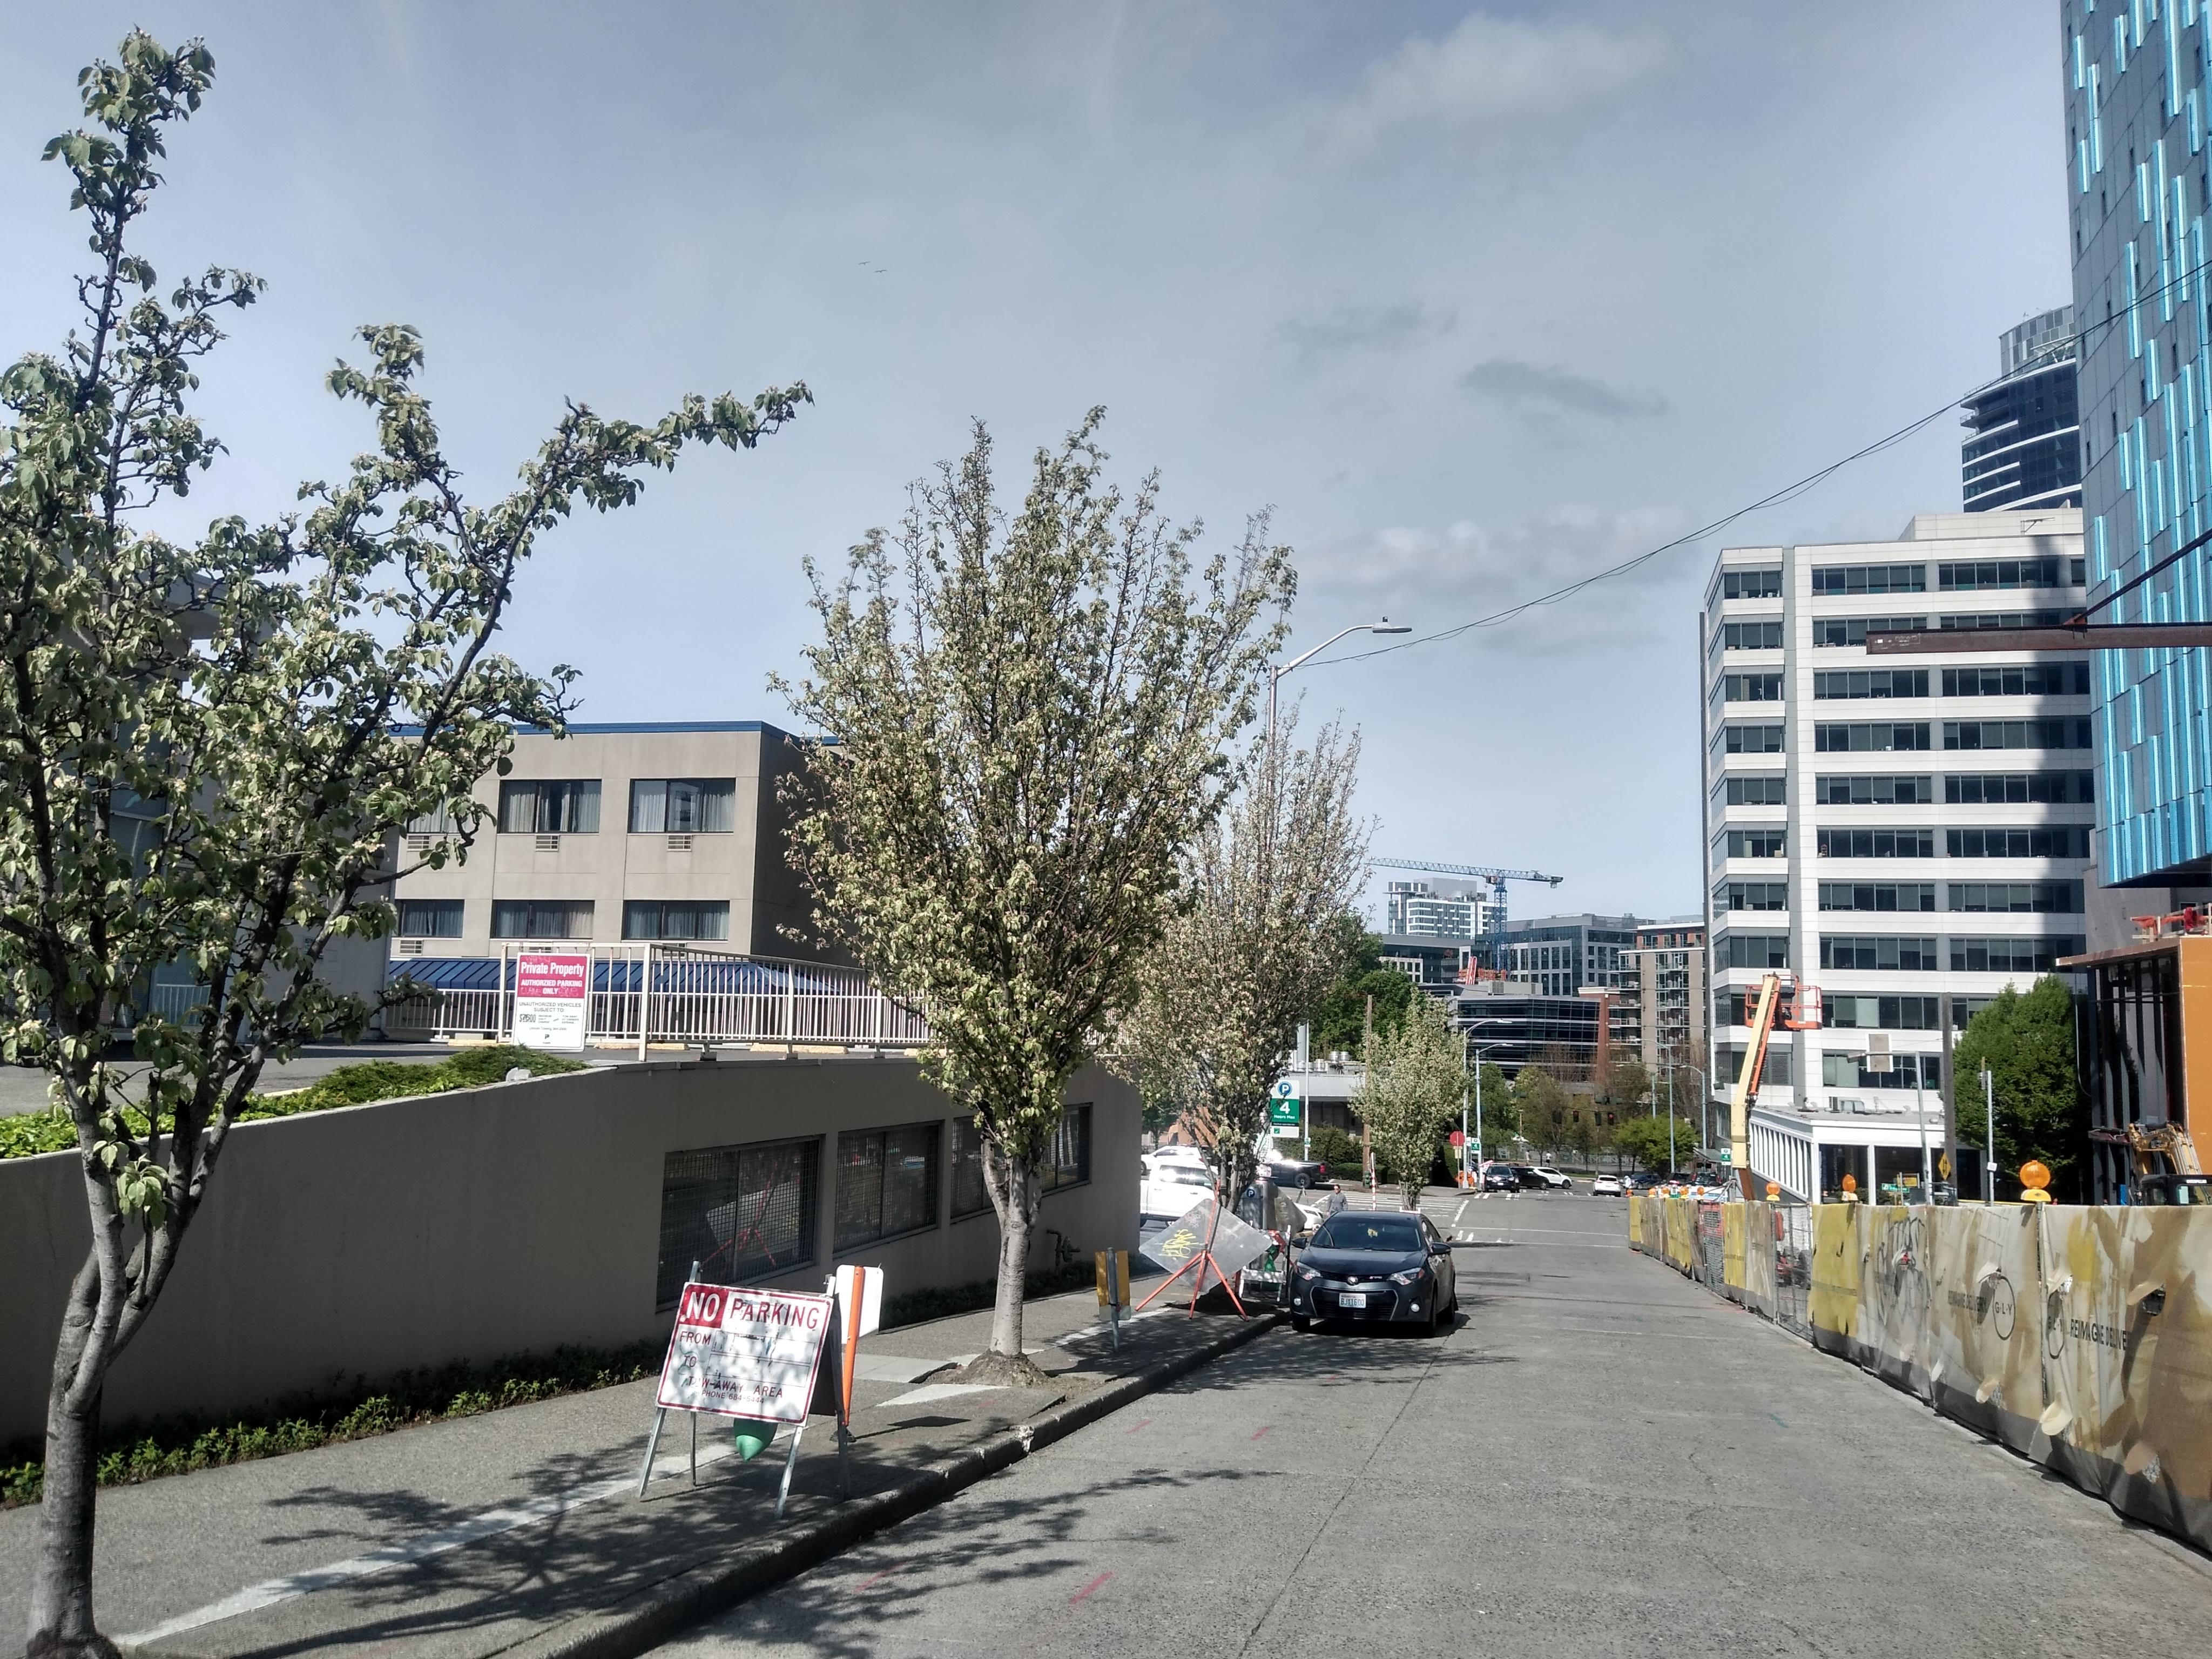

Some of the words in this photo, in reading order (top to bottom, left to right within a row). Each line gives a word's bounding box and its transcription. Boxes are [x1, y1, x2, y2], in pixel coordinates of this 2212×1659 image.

[521, 962, 548, 974] Private
[550, 962, 584, 977] Property
[1279, 1101, 1290, 1114] 4
[686, 1291, 720, 1321] NO
[730, 1298, 820, 1329] PARKING
[679, 1331, 712, 1345] FROM
[684, 1355, 697, 1367] TO
[689, 1376, 744, 1393] TW-AWAY
[753, 1385, 783, 1398] AREA
[702, 1390, 725, 1399] PHONE
[729, 1393, 765, 1404] 684-5444
